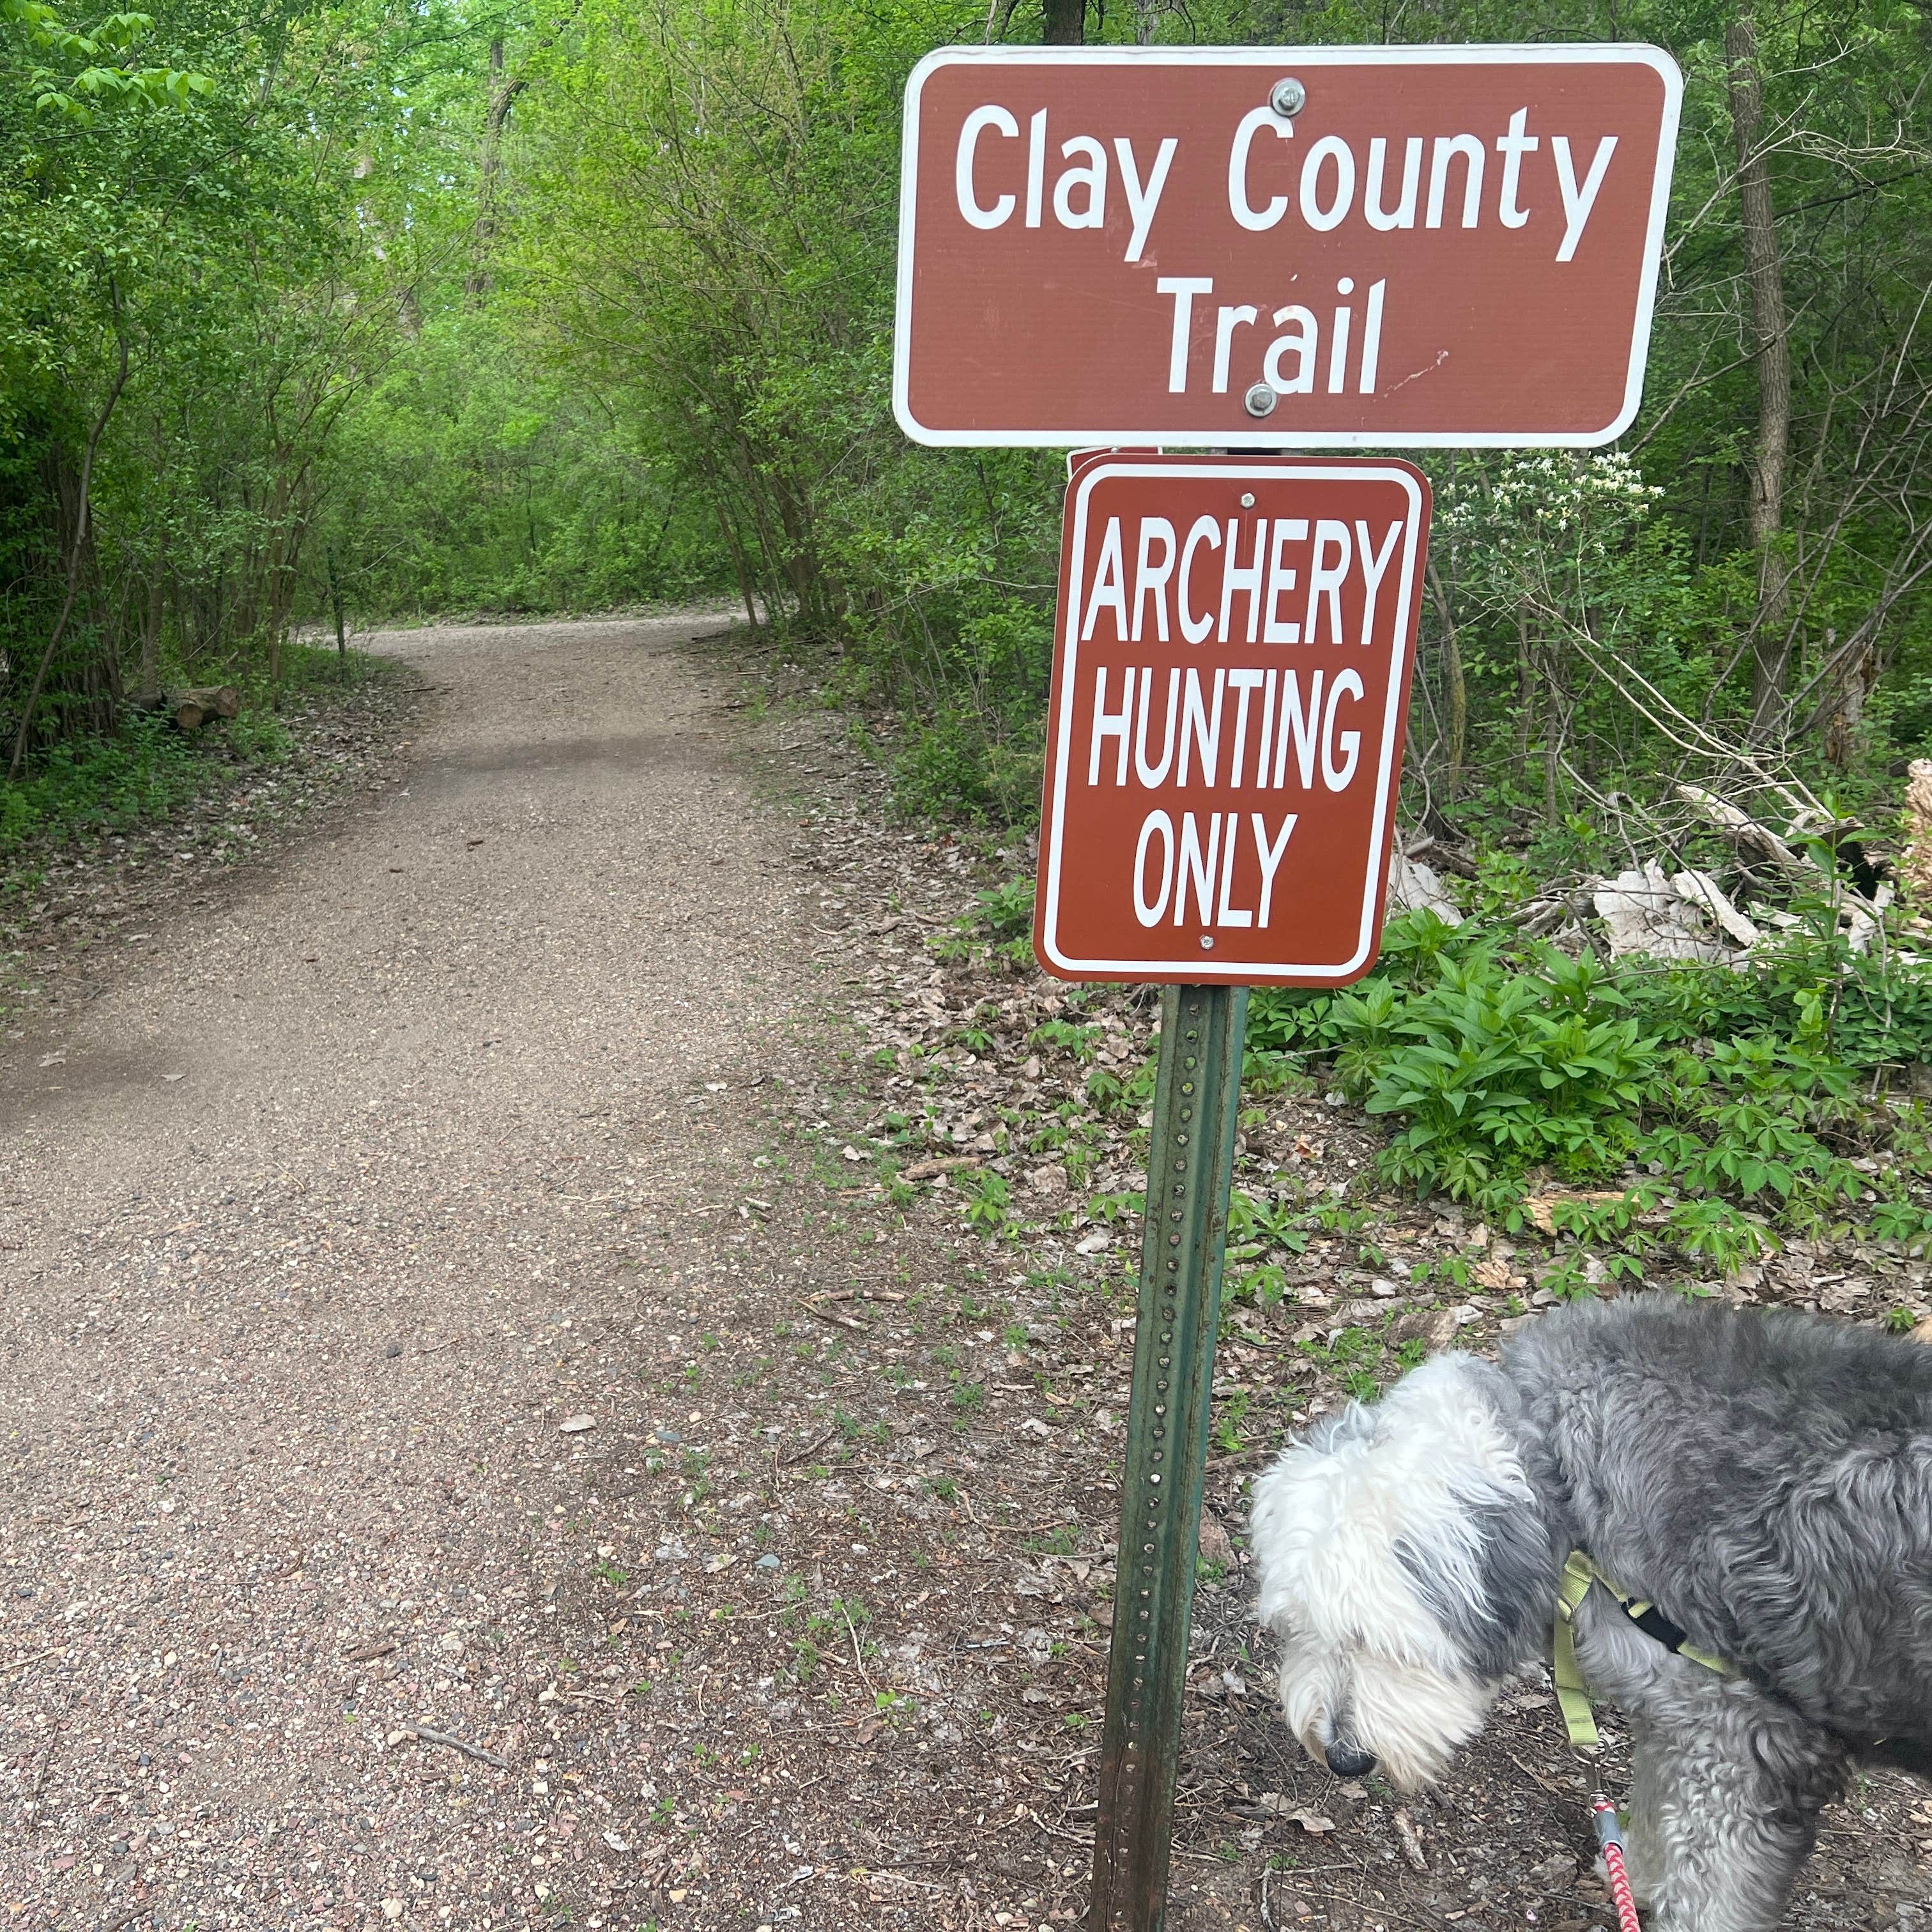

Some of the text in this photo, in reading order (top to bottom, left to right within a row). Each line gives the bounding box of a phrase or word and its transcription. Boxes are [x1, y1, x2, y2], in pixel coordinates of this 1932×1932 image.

[953, 104, 1618, 263] Clay County
[1156, 276, 1386, 395] Trail
[1081, 514, 1404, 645] ARCHERY
[1087, 666, 1365, 793] HUNTING
[1133, 808, 1299, 928] ONLY
